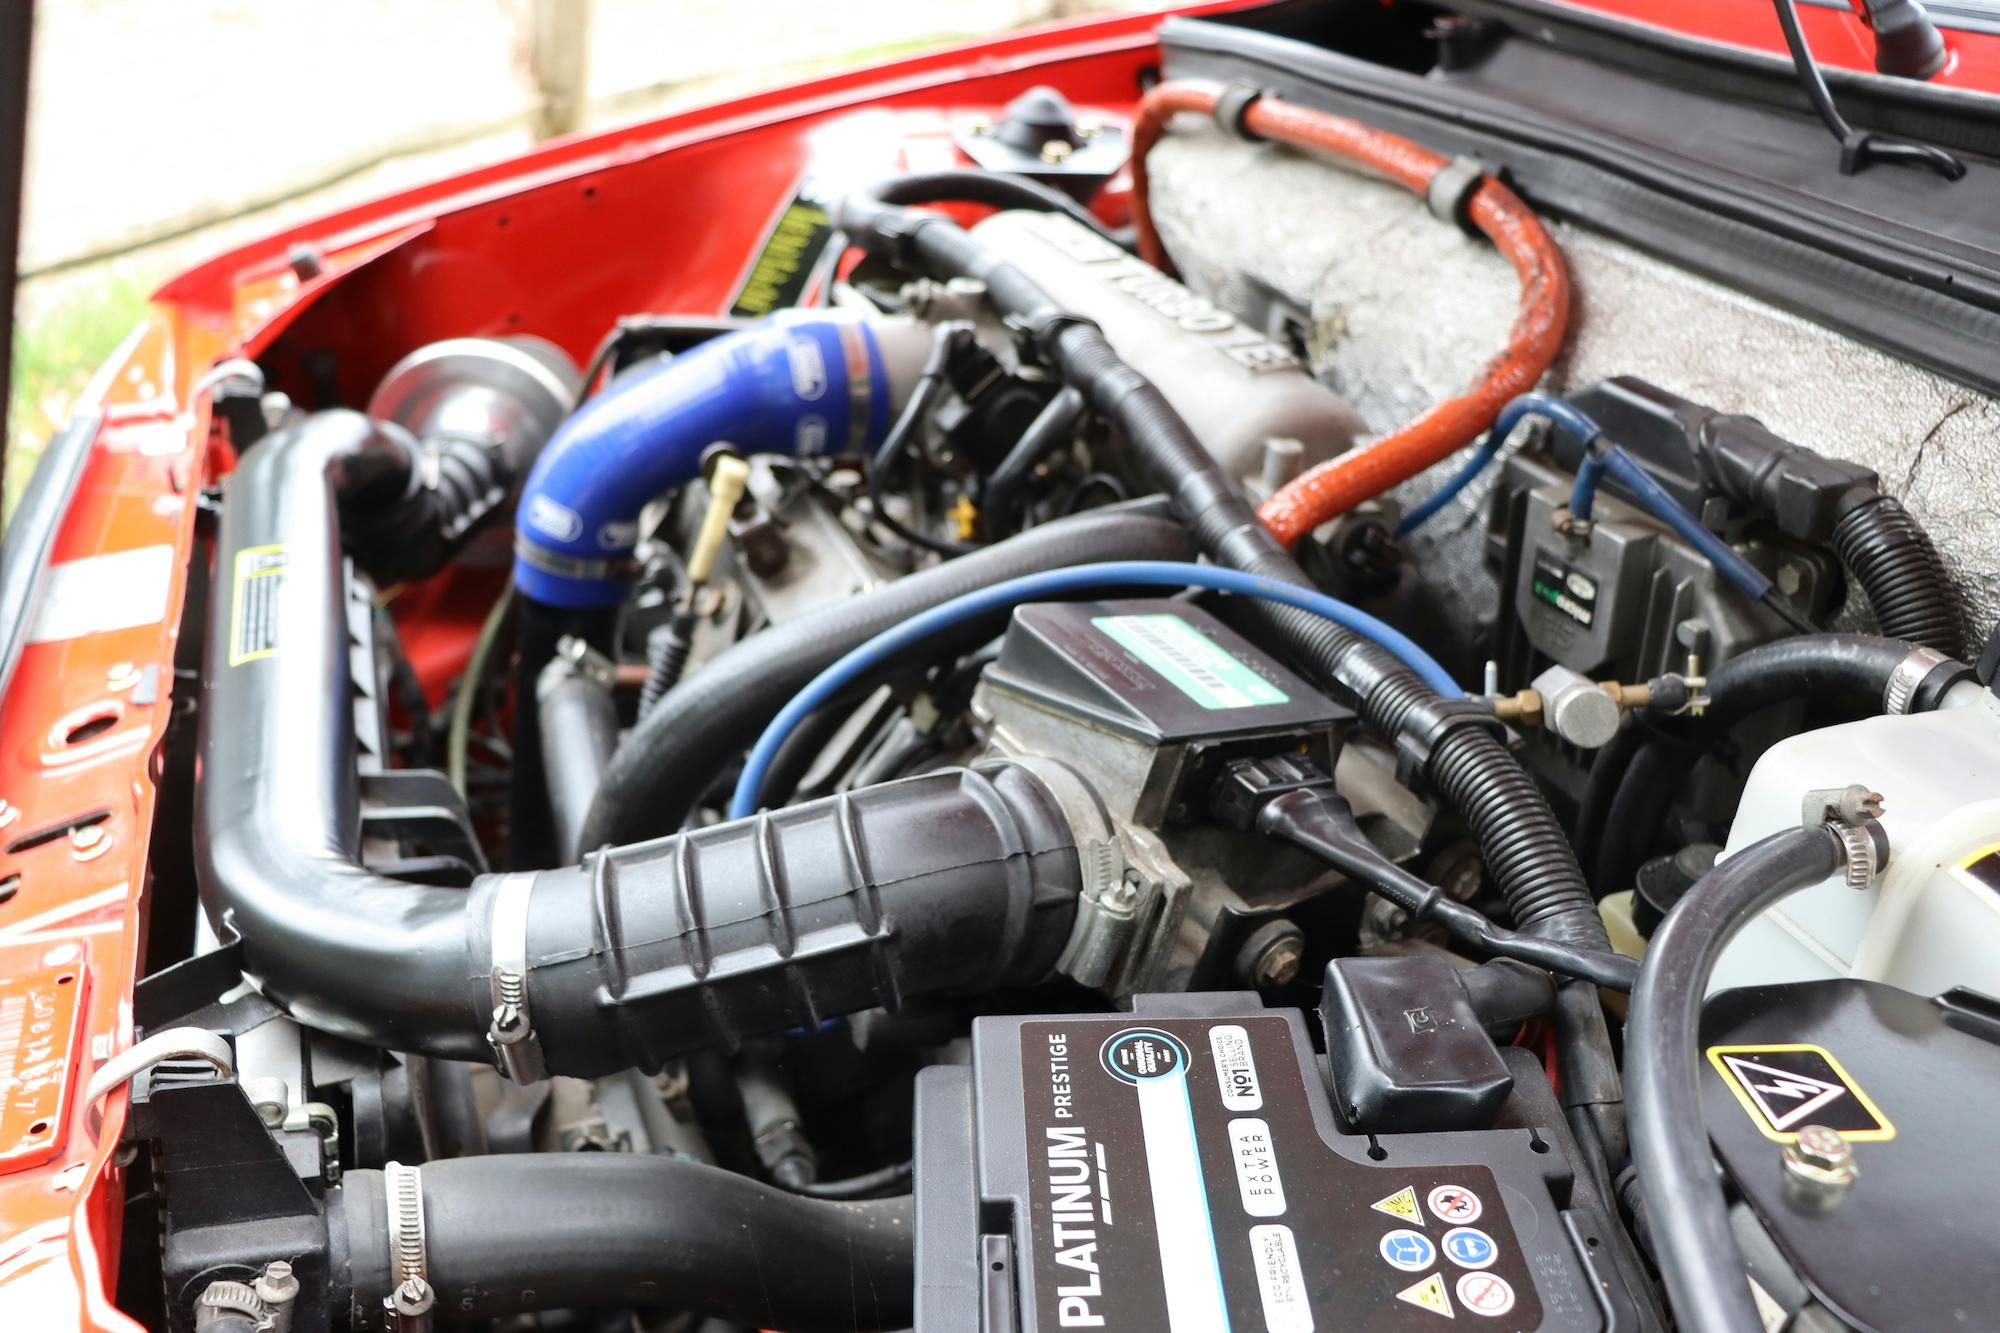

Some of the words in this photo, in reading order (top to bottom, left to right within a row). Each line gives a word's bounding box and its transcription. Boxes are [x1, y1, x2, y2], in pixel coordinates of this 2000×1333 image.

[1134, 1040, 1147, 1074] ORIGINAL
[1144, 1041, 1157, 1073] QUALITY
[1215, 1035, 1226, 1057] CHOICE
[1224, 1034, 1238, 1067] SELLING
[1235, 1038, 1248, 1067] BRAND
[1049, 1033, 1073, 1118] PRESTIGE
[1221, 1058, 1235, 1097] CONSUMER'S
[1239, 1135, 1261, 1195] EXTRA
[1253, 1134, 1274, 1195] POWER
[1045, 1126, 1106, 1327] PLATINUM
[1263, 1236, 1276, 1281] FRIENDLY
[1273, 1232, 1289, 1284] RECYCLABLE
[1273, 1284, 1283, 1304] ECO
